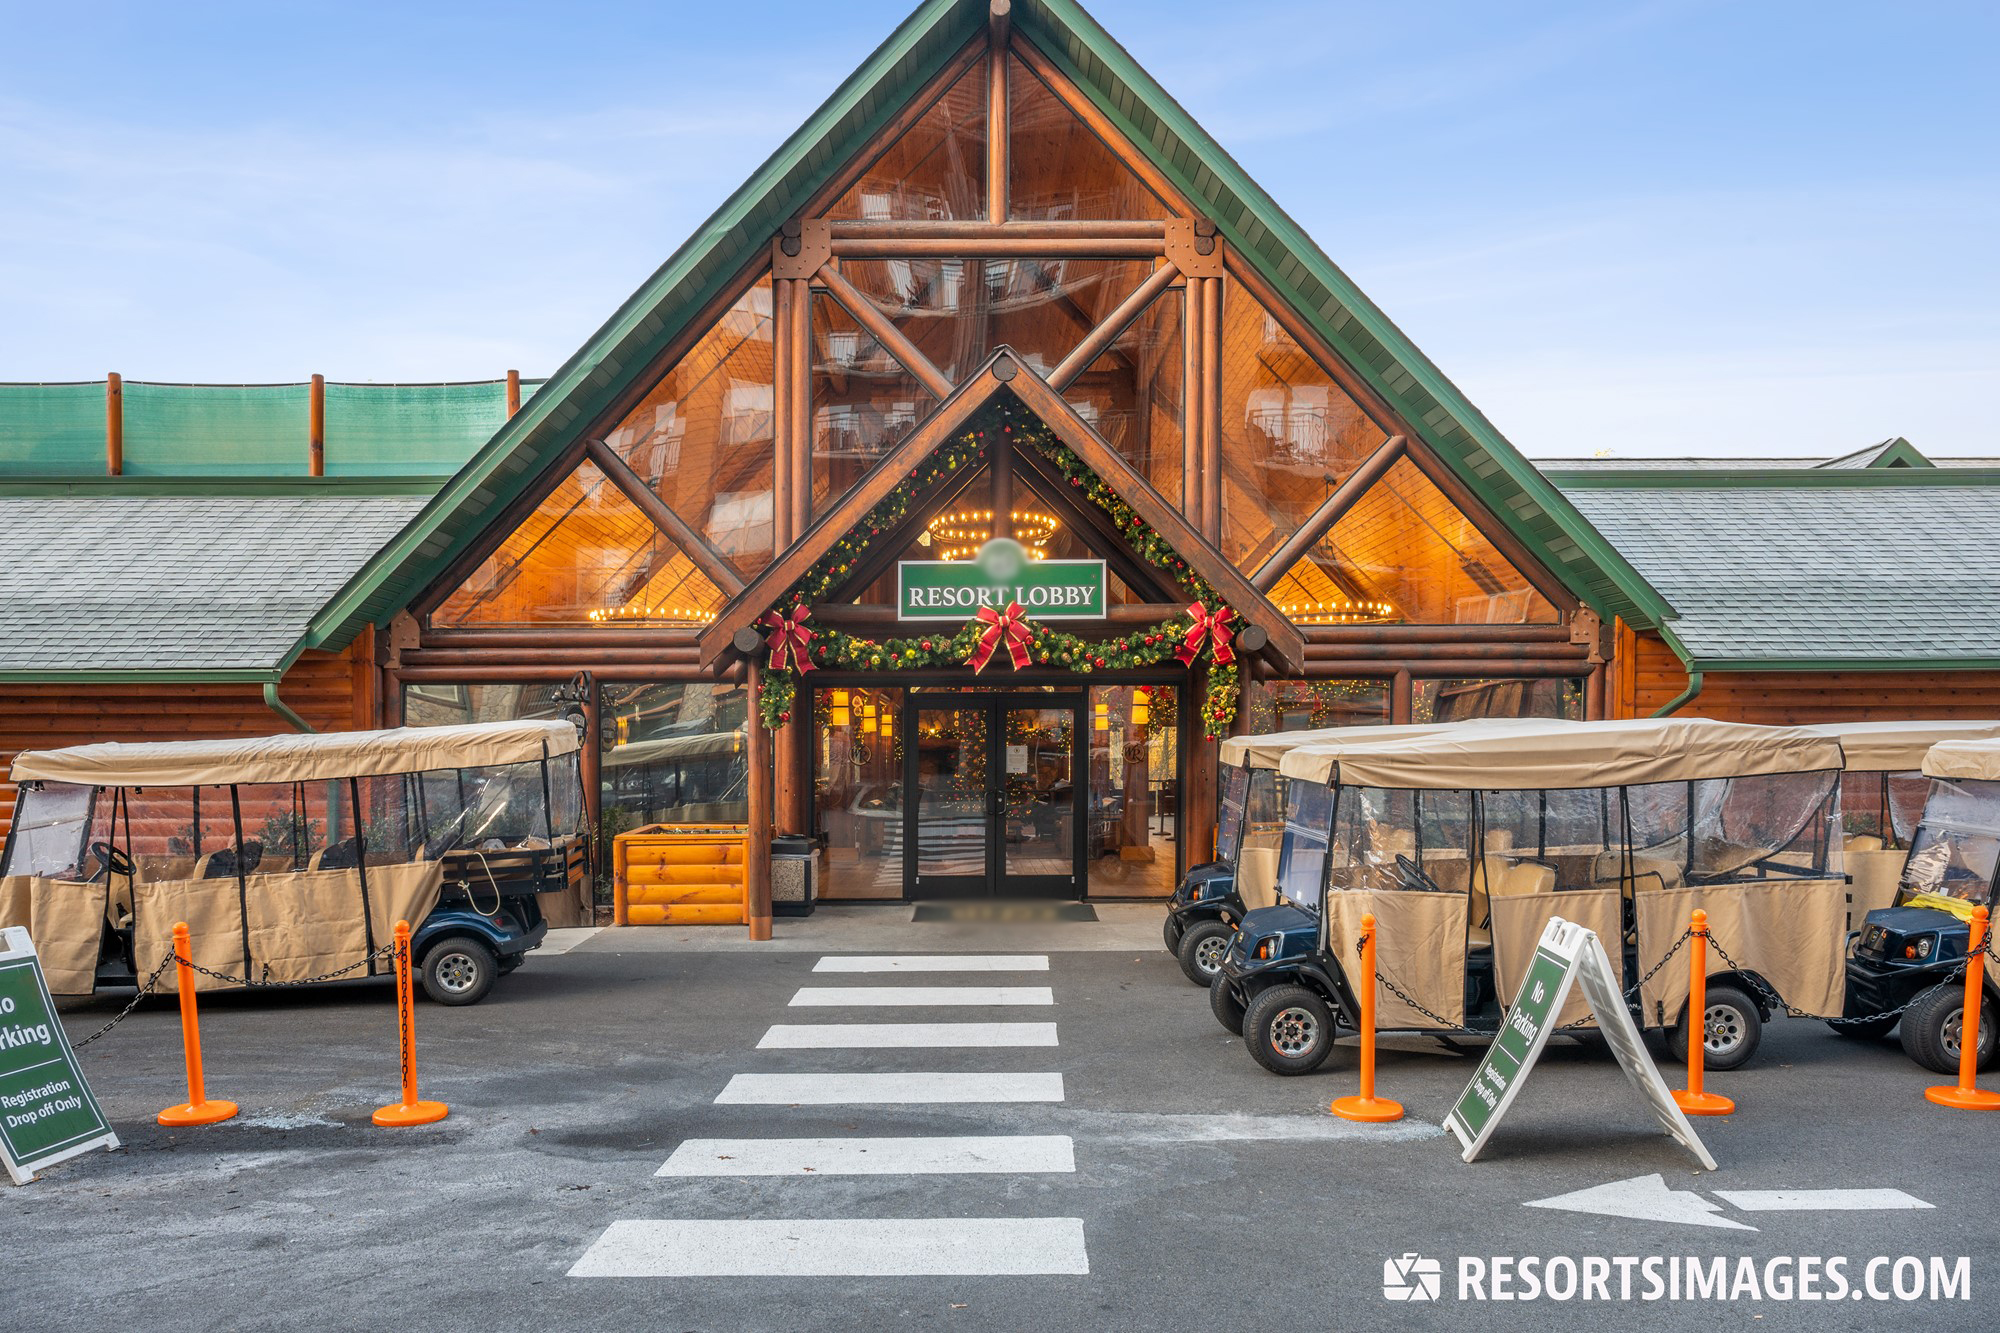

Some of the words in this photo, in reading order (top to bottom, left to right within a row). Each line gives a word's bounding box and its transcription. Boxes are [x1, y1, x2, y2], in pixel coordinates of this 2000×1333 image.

[909, 586, 1010, 606] RESORT
[1015, 586, 1096, 606] LOBBY
[1530, 980, 1545, 1004] No
[0, 997, 15, 1015] o
[1510, 1006, 1538, 1047] Parking
[0, 1080, 71, 1109] Registration
[6, 1111, 38, 1128] Drop
[38, 1101, 55, 1118] off
[55, 1095, 82, 1112] Only
